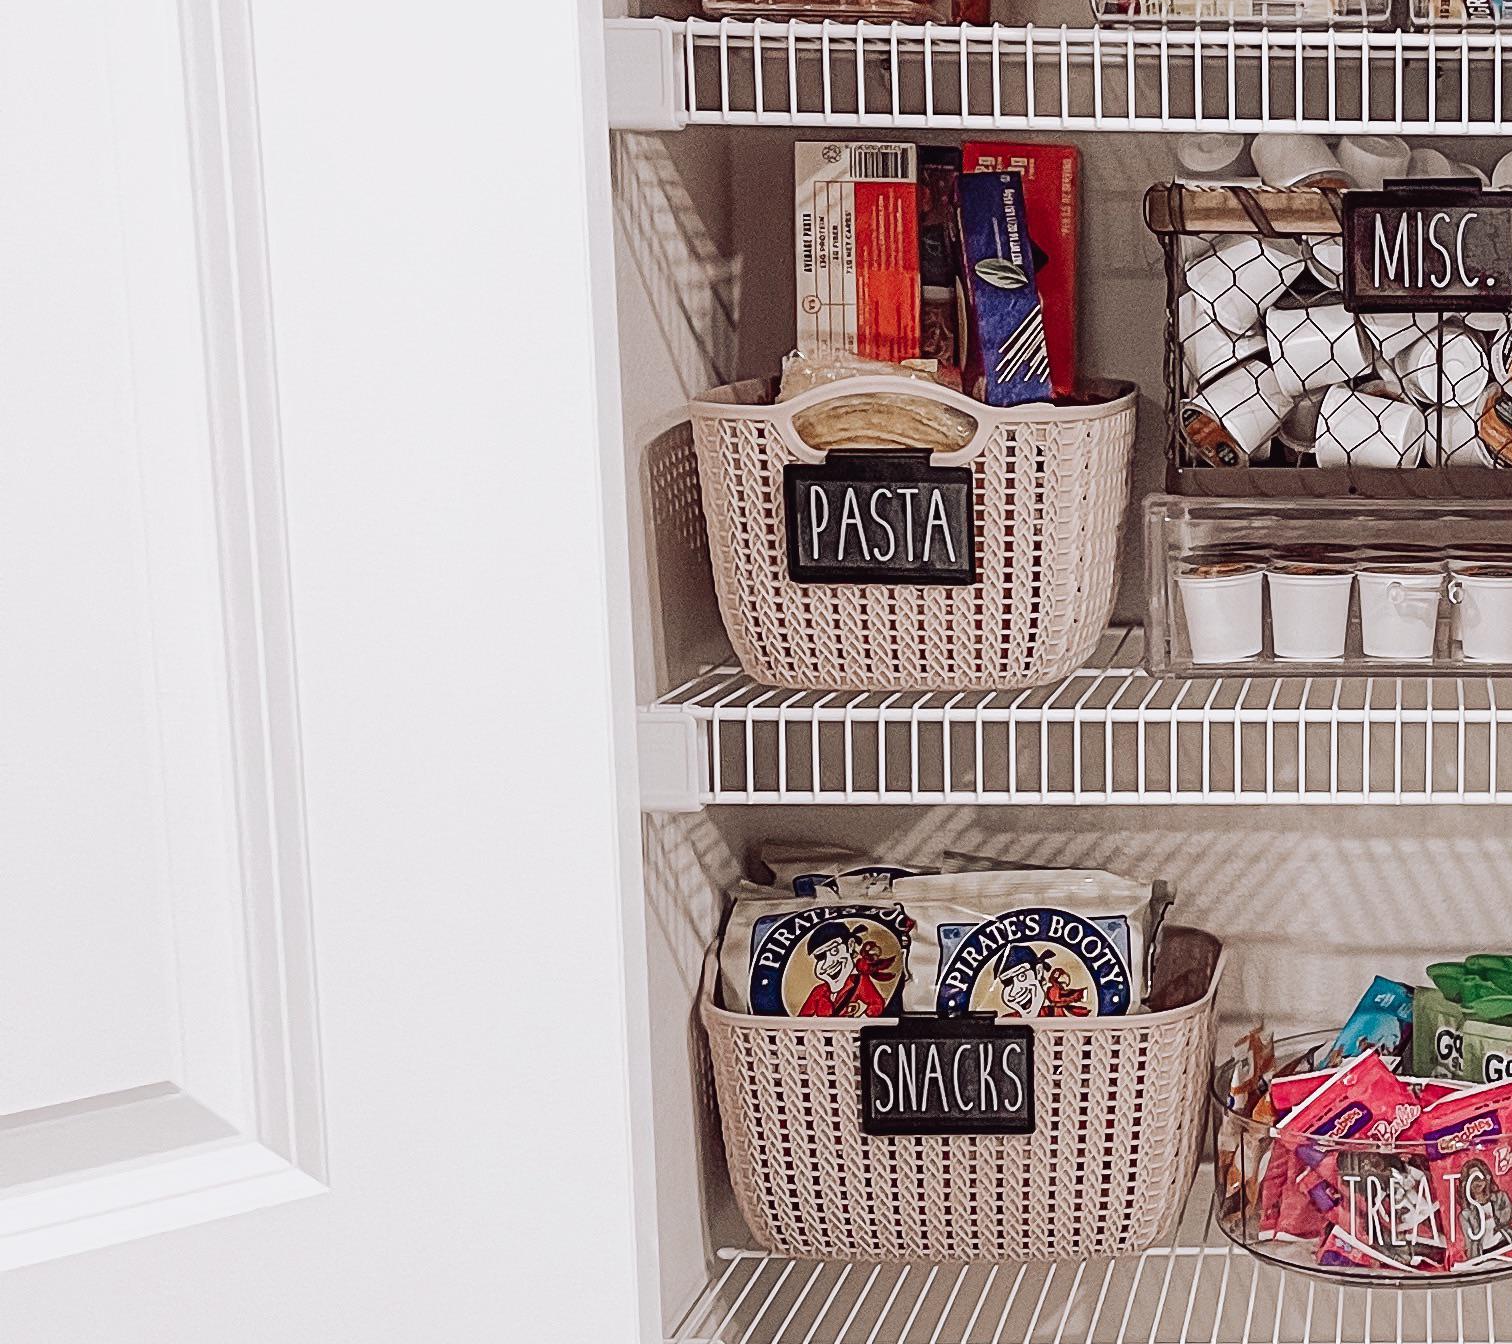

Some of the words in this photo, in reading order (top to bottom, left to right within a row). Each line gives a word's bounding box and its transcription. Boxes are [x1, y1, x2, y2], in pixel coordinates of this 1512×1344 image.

[1373, 213, 1495, 290] MISC.
[810, 486, 957, 563] PASTA
[946, 914, 1040, 991] PIRATE'S
[1048, 915, 1124, 985] BOOTY
[873, 1043, 1023, 1113] SNACKS
[1343, 1170, 1487, 1247] TREATS
